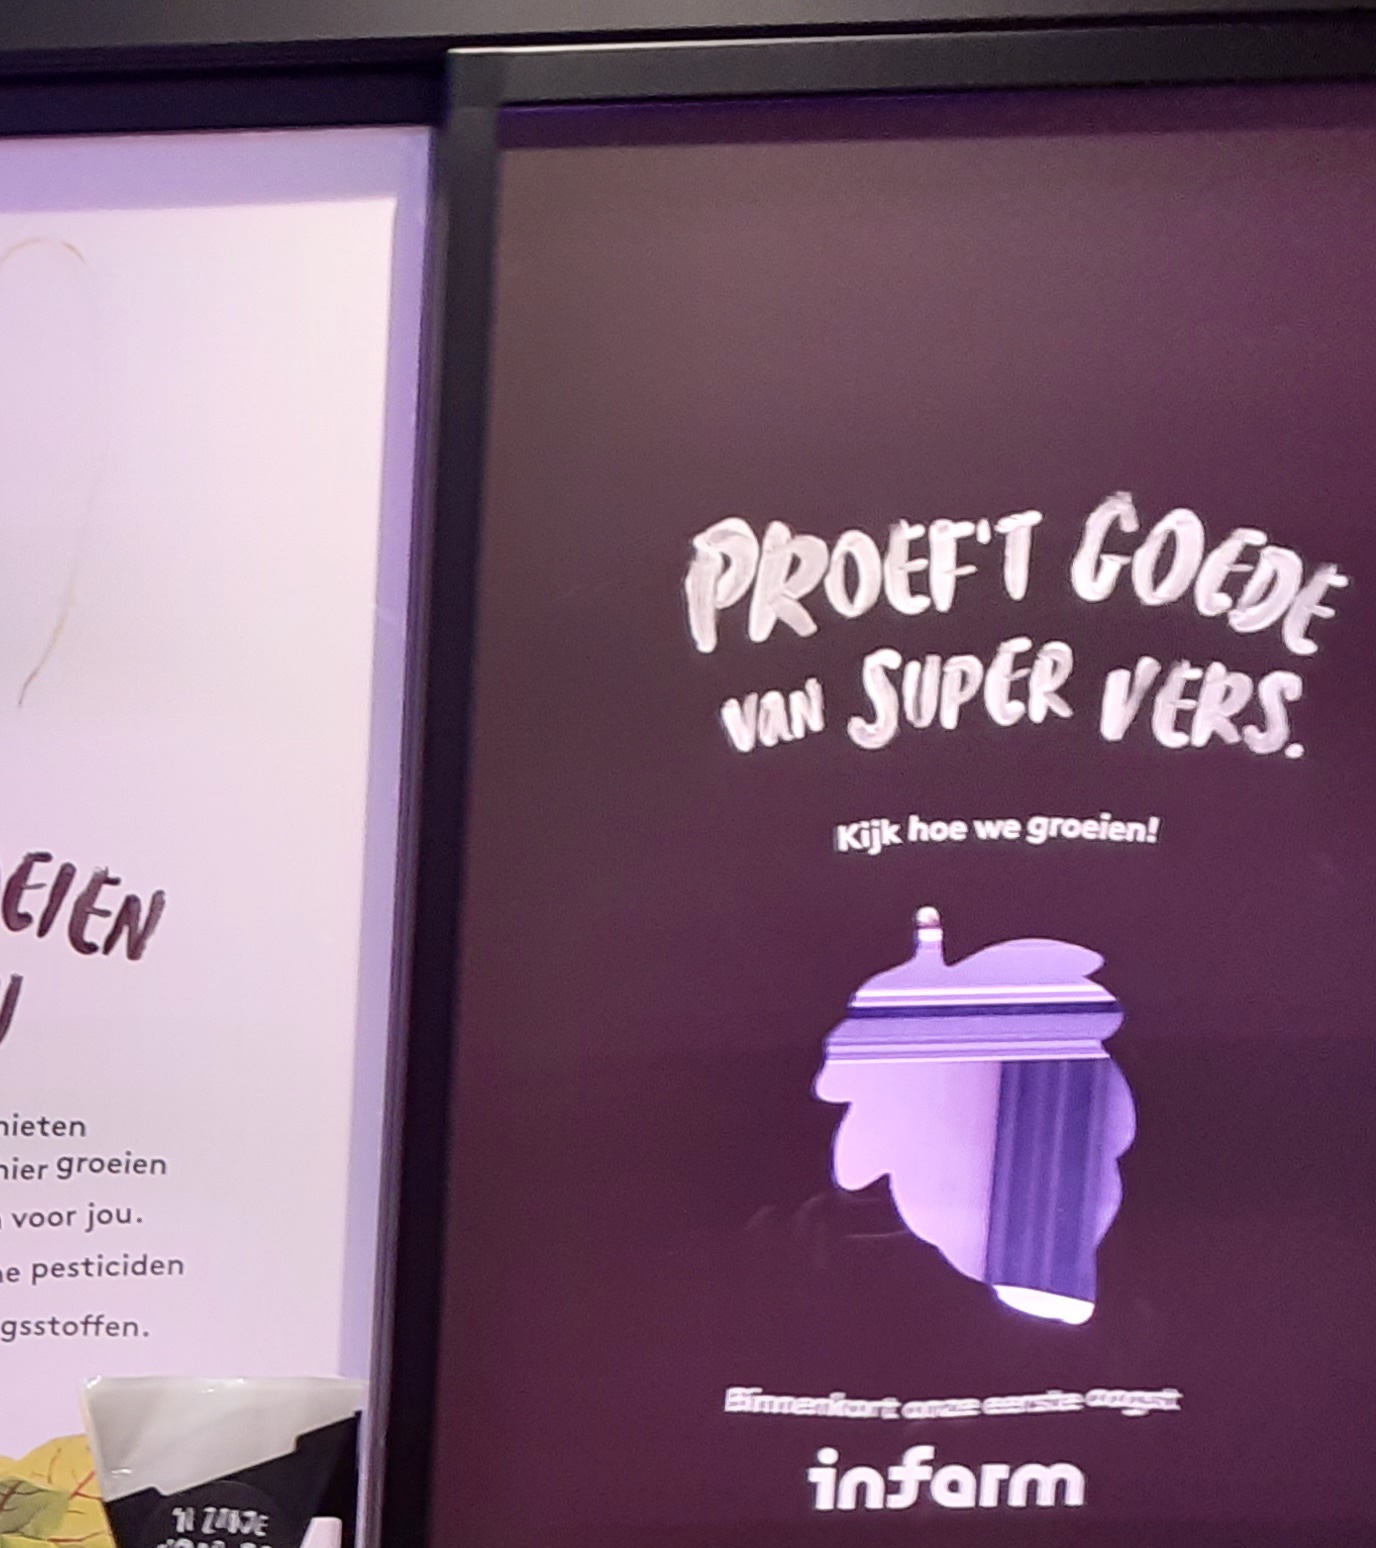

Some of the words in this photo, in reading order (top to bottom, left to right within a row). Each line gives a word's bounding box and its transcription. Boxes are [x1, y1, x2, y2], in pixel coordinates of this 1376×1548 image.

[684, 509, 1045, 653] PROEF'T
[1070, 490, 1350, 655] GOEDE
[847, 636, 1073, 750] SUPER
[1098, 654, 1312, 759] VERS.
[837, 818, 903, 856] Kijk
[907, 814, 969, 842] hoe
[973, 818, 1022, 840] we
[1025, 812, 1160, 845] groeien!
[56, 1150, 167, 1181] groeien
[11, 1210, 77, 1229] voor
[84, 1201, 143, 1233] jou.
[31, 1253, 184, 1286] pesticiden
[807, 1445, 1085, 1511] infarm
